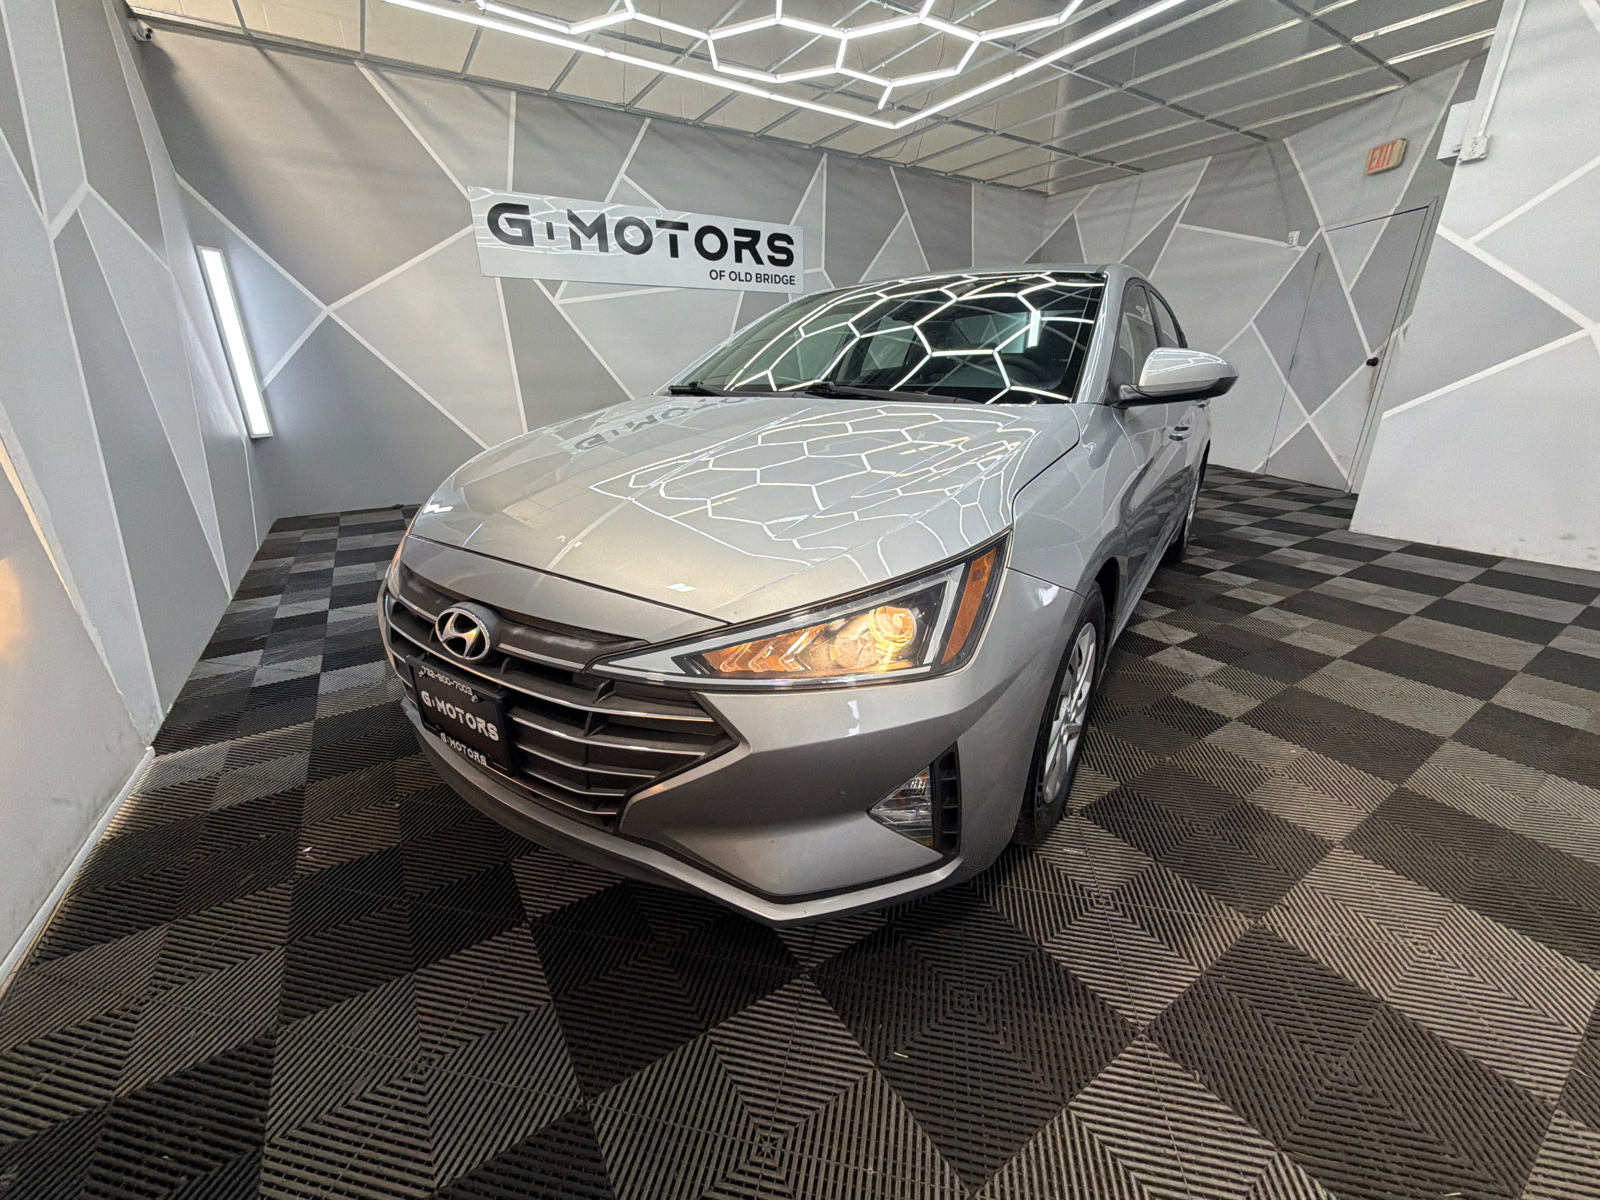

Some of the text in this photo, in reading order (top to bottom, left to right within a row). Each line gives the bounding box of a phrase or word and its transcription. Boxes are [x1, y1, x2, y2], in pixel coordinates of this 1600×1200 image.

[1367, 140, 1398, 172] EXIT
[709, 269, 796, 286] OF OLD BRIDGE
